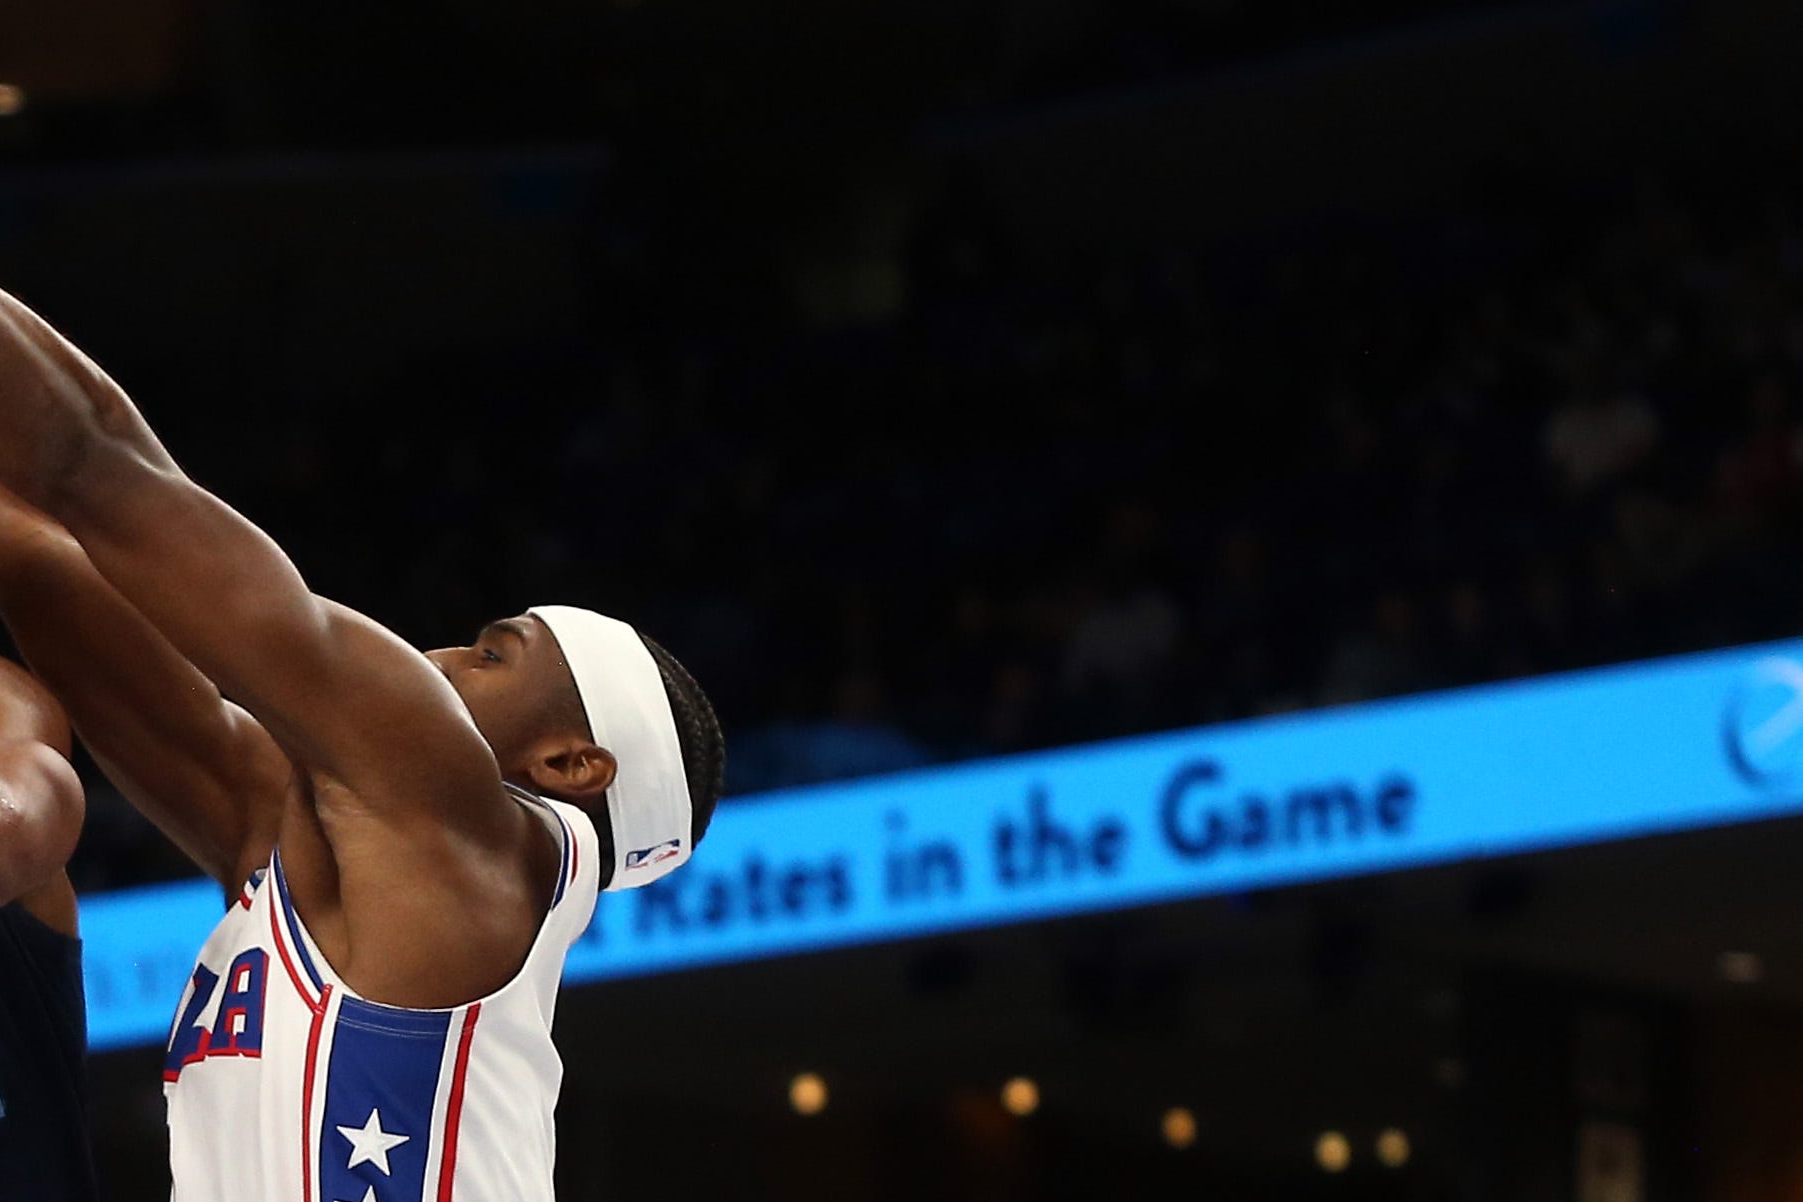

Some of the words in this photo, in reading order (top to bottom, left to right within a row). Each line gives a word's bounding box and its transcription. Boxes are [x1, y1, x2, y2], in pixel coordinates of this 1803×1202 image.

[881, 808, 966, 902] in
[990, 781, 1127, 887] the
[1158, 758, 1419, 864] Game
